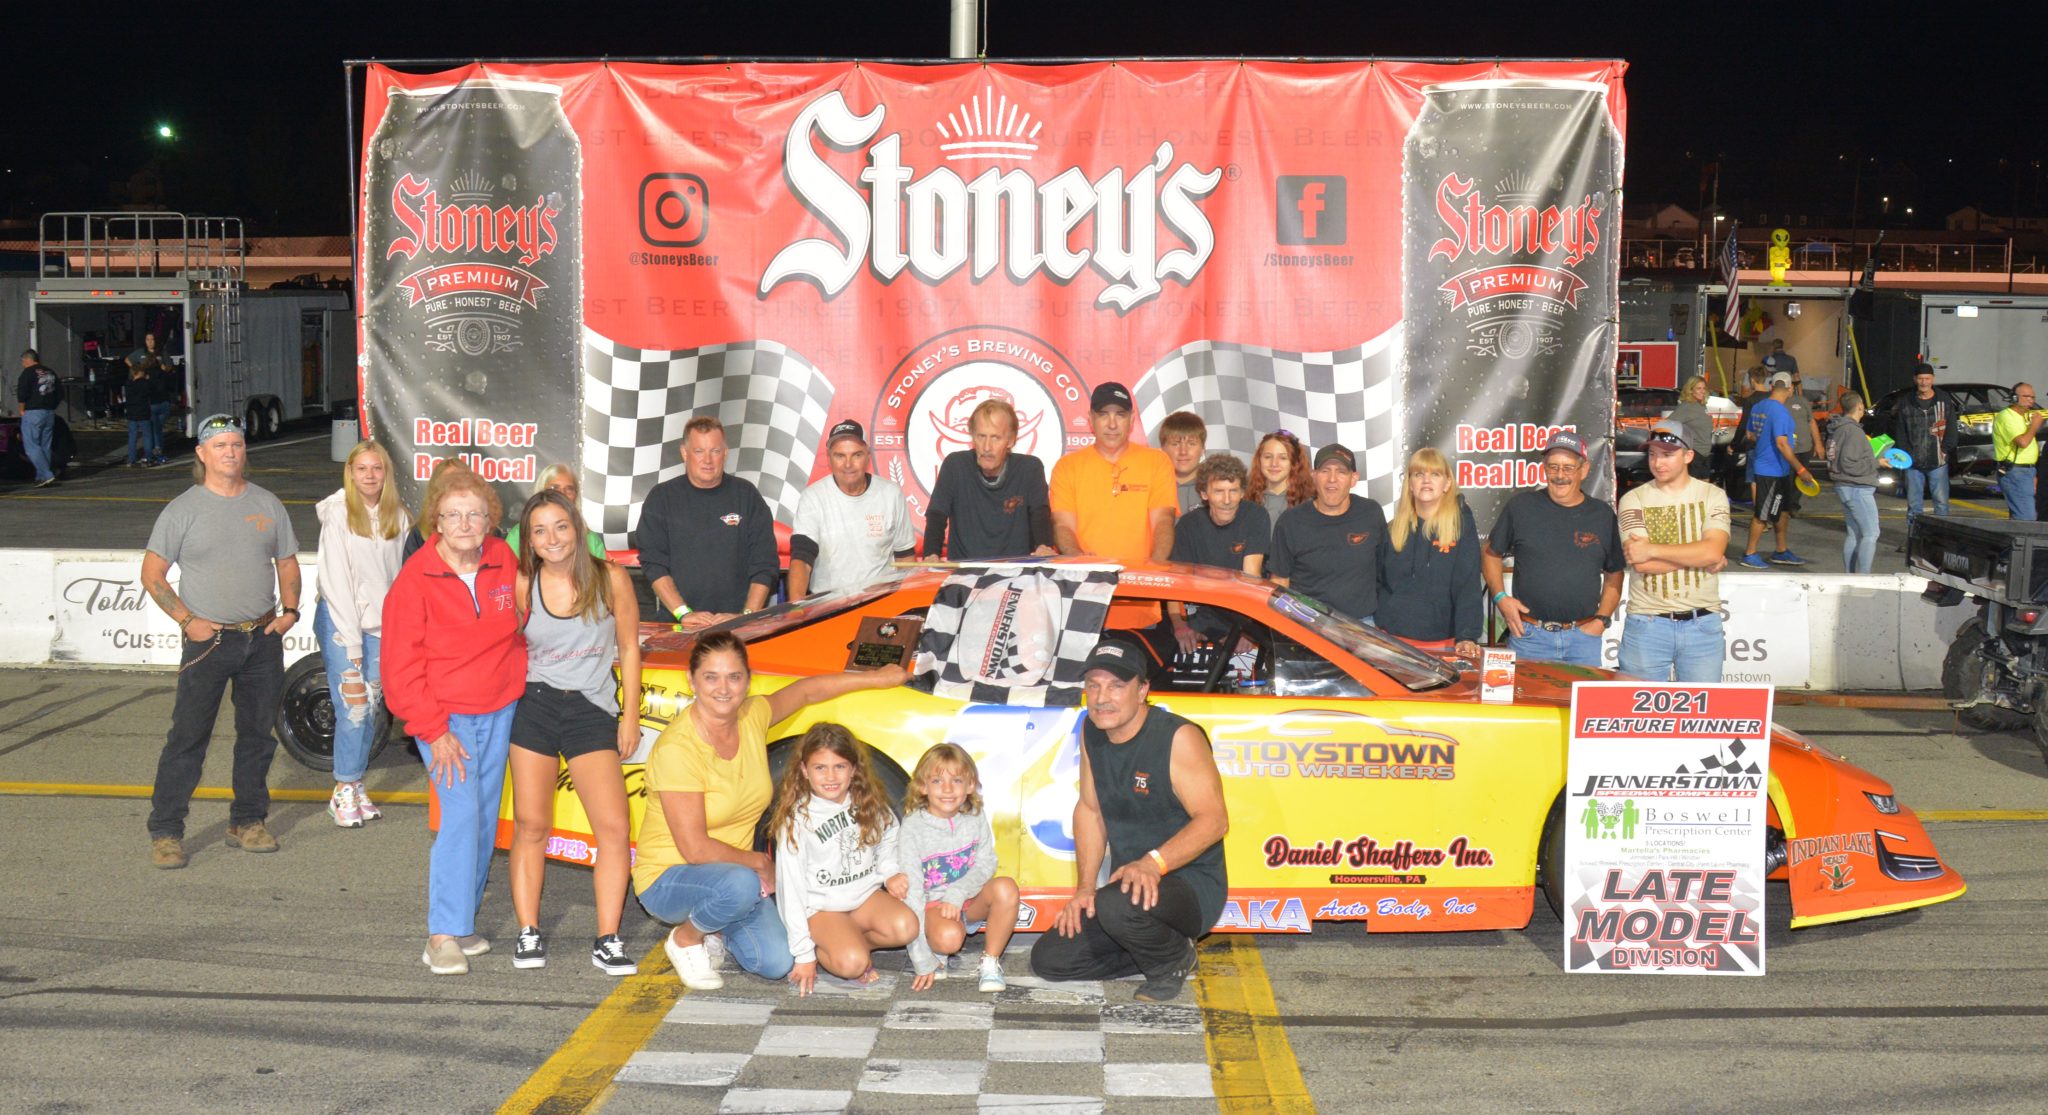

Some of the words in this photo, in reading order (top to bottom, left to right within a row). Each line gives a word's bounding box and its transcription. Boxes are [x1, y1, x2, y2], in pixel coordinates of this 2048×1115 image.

[1460, 102, 1573, 110] WWW.STONEYSBEER.COM
[758, 89, 1223, 313] Stoney's
[386, 172, 559, 267] Stoney's
[1427, 171, 1603, 267] Stoney's
[629, 251, 720, 267] @StoneysBeer
[1264, 252, 1354, 267] /StoneysBeer
[427, 270, 519, 292] PREMIUM
[1469, 273, 1564, 294] PREMIUM
[425, 299, 448, 314] PURE
[455, 297, 492, 308] HONEST
[498, 300, 521, 314] BEER
[1467, 302, 1491, 318] PURE
[1498, 300, 1534, 311] HONEST
[1541, 302, 1564, 317] BEER
[493, 333, 511, 341] 1907
[1536, 337, 1553, 345] 1907
[887, 345, 960, 409] STONEY'S
[967, 339, 1053, 374] BREWING
[1055, 373, 1079, 402] CO
[414, 418, 471, 446] Real
[475, 418, 537, 447] Beer
[875, 435, 904, 445] EST
[1066, 437, 1096, 446] 1907
[1456, 423, 1516, 452] Real
[1456, 459, 1513, 488] Real
[64, 577, 147, 615] Total
[985, 582, 1024, 679] JENNERSTOWN
[1487, 652, 1513, 661] FRAM
[1632, 691, 1708, 714] 2021
[1582, 717, 1675, 735] FEATURE
[1679, 718, 1761, 735] WINNER
[1213, 741, 1456, 766] STOYSTOWN
[1134, 776, 1147, 789] 75
[1299, 763, 1456, 781] WRECKERS
[1572, 775, 1762, 797] JENNERSTOWN
[1595, 789, 1667, 797] SPEEDWAY
[1669, 790, 1730, 798] COMPLEX
[1645, 807, 1751, 822] Boswell
[814, 810, 849, 845] NORTH
[1645, 826, 1711, 837] Prescription
[1714, 826, 1752, 836] Center
[1263, 834, 1343, 870] Daniel
[1345, 835, 1447, 872] Shaffers
[1449, 835, 1495, 868] Inc.
[1791, 835, 1841, 867] INDIAN
[1841, 832, 1875, 857] LAKE
[1334, 874, 1403, 885] Hooversville,
[1405, 874, 1421, 884] PA
[1602, 869, 1736, 903] LATE
[1316, 898, 1370, 918] Auto
[1443, 897, 1477, 914] Inc
[1577, 909, 1759, 944] MODEL
[1612, 946, 1718, 968] DIVISION
